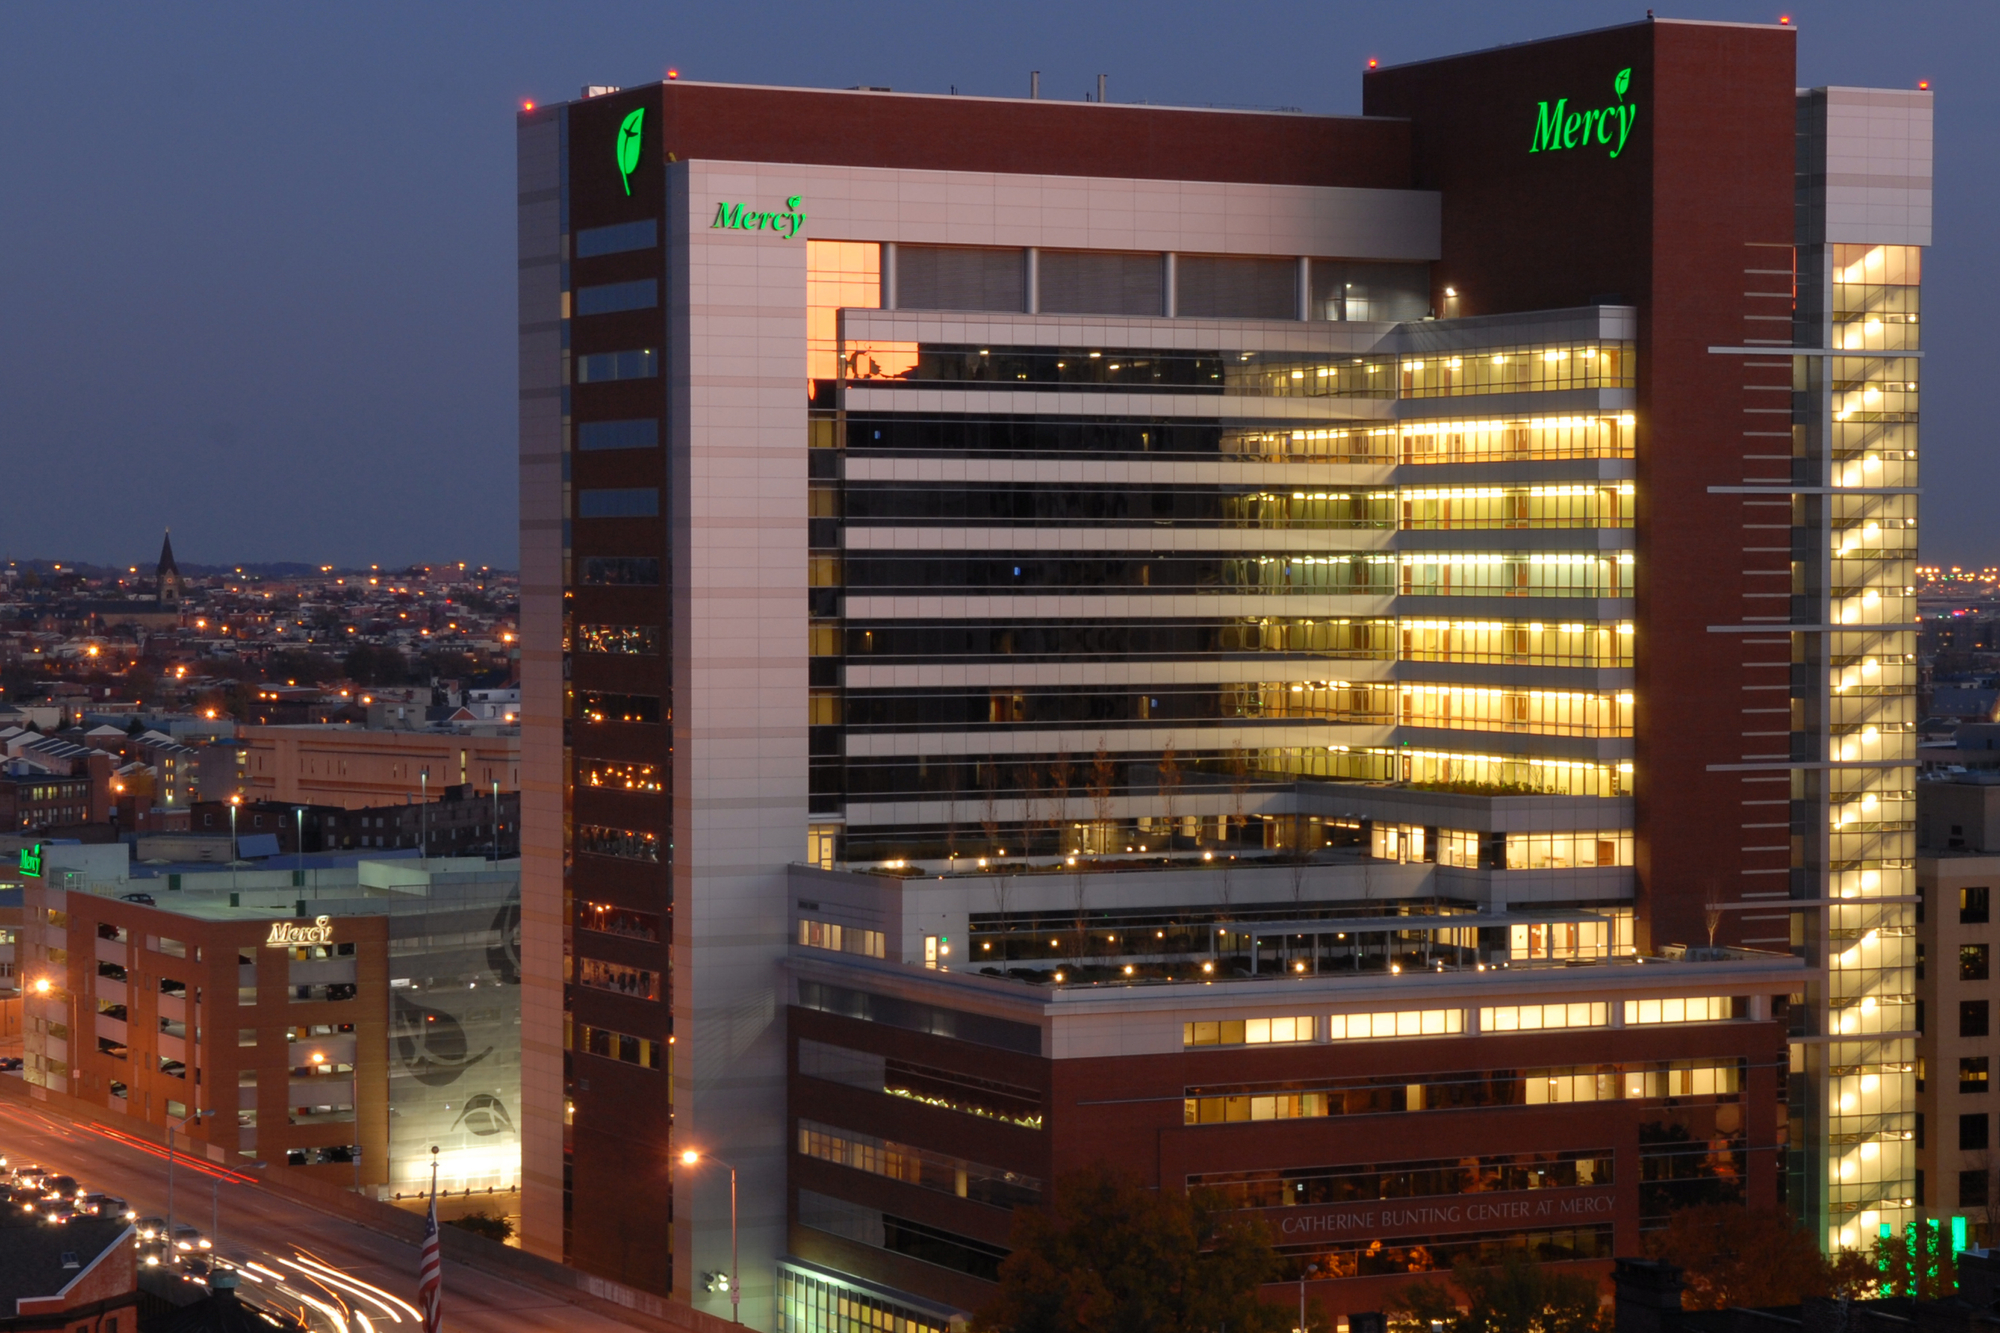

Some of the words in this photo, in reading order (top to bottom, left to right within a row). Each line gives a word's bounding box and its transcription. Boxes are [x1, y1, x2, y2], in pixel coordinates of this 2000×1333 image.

[1529, 97, 1637, 159] Mercy
[710, 201, 807, 239] Mercy
[266, 922, 333, 943] Mercy
[1282, 1212, 1375, 1234] CATHERINE
[1382, 1206, 1461, 1227] BUNTING
[1466, 1201, 1530, 1221] CENTER
[1535, 1199, 1554, 1216] AT
[1559, 1195, 1616, 1214] MERCY
